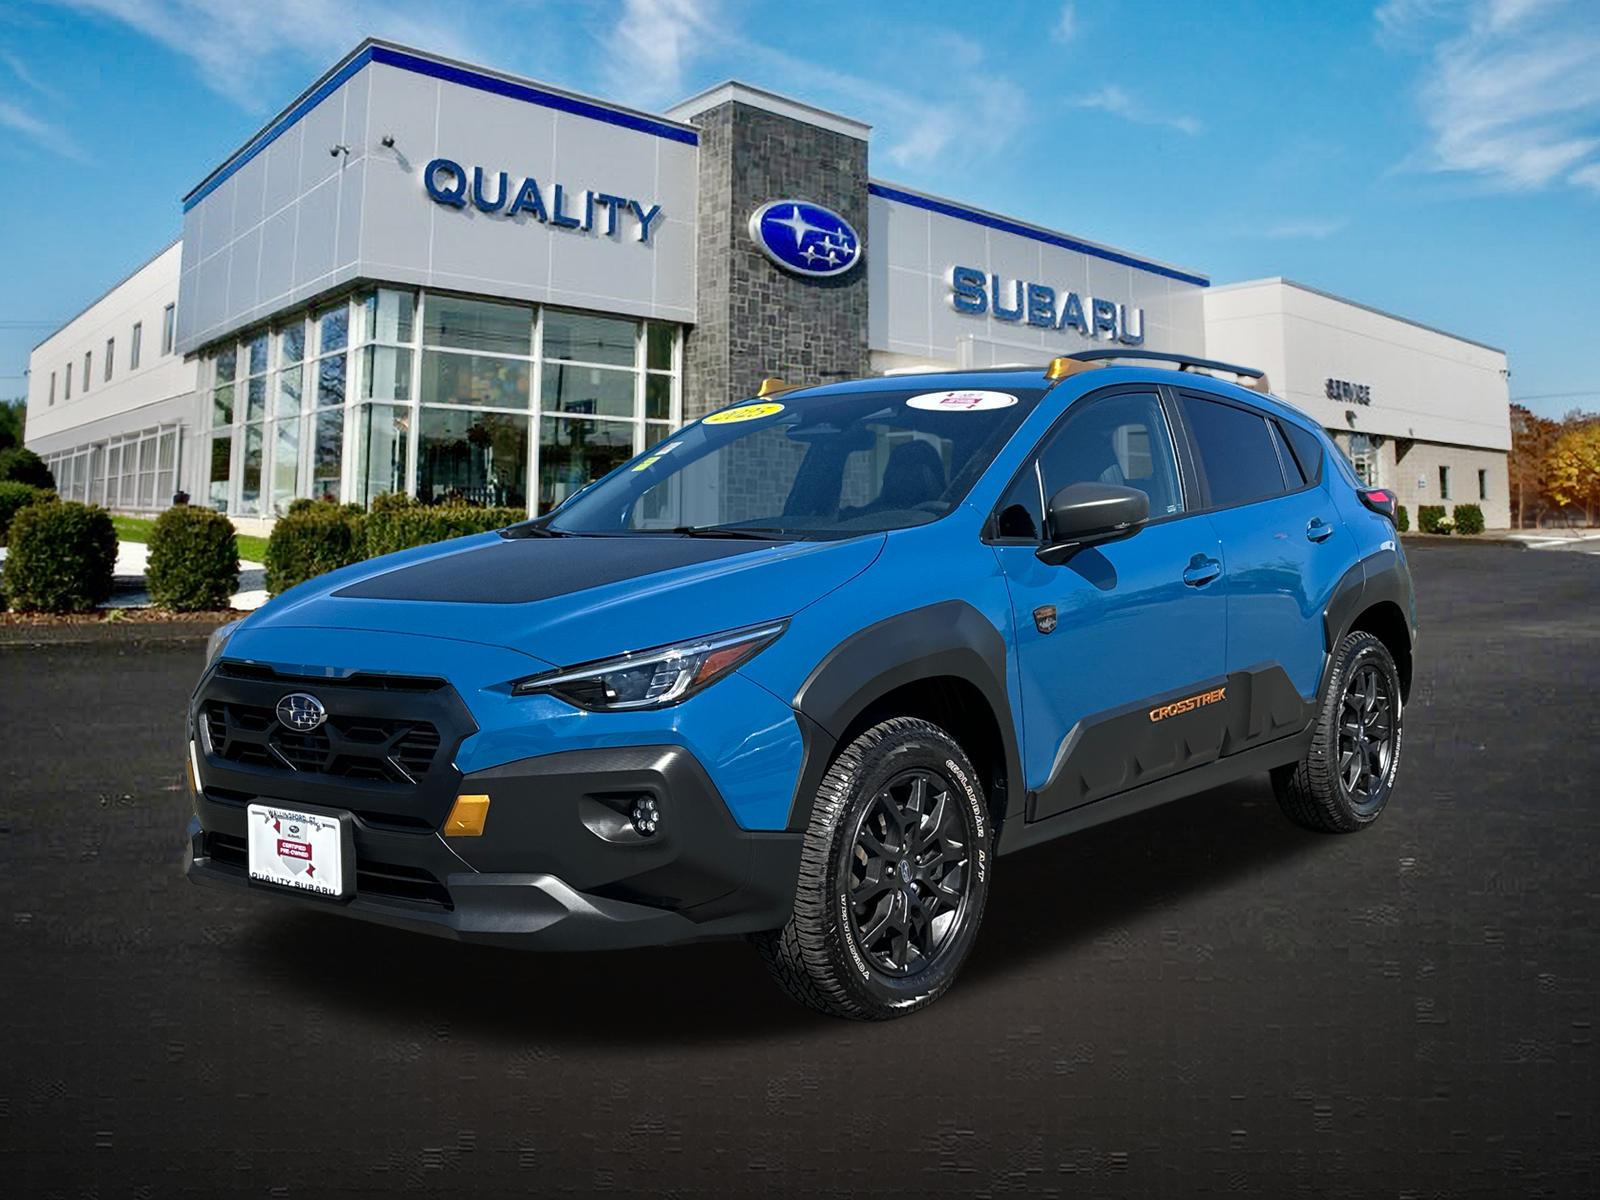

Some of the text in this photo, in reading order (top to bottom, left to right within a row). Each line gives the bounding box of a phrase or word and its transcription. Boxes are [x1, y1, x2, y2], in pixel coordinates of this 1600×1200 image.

[424, 158, 661, 242] QUALITY
[951, 265, 1145, 346] SUBARU
[1149, 687, 1226, 722] CROSSTREK
[280, 847, 309, 858] PRE-OWNED
[281, 841, 307, 852] CERTIFIED
[251, 871, 336, 895] QUALITY SUBARU
